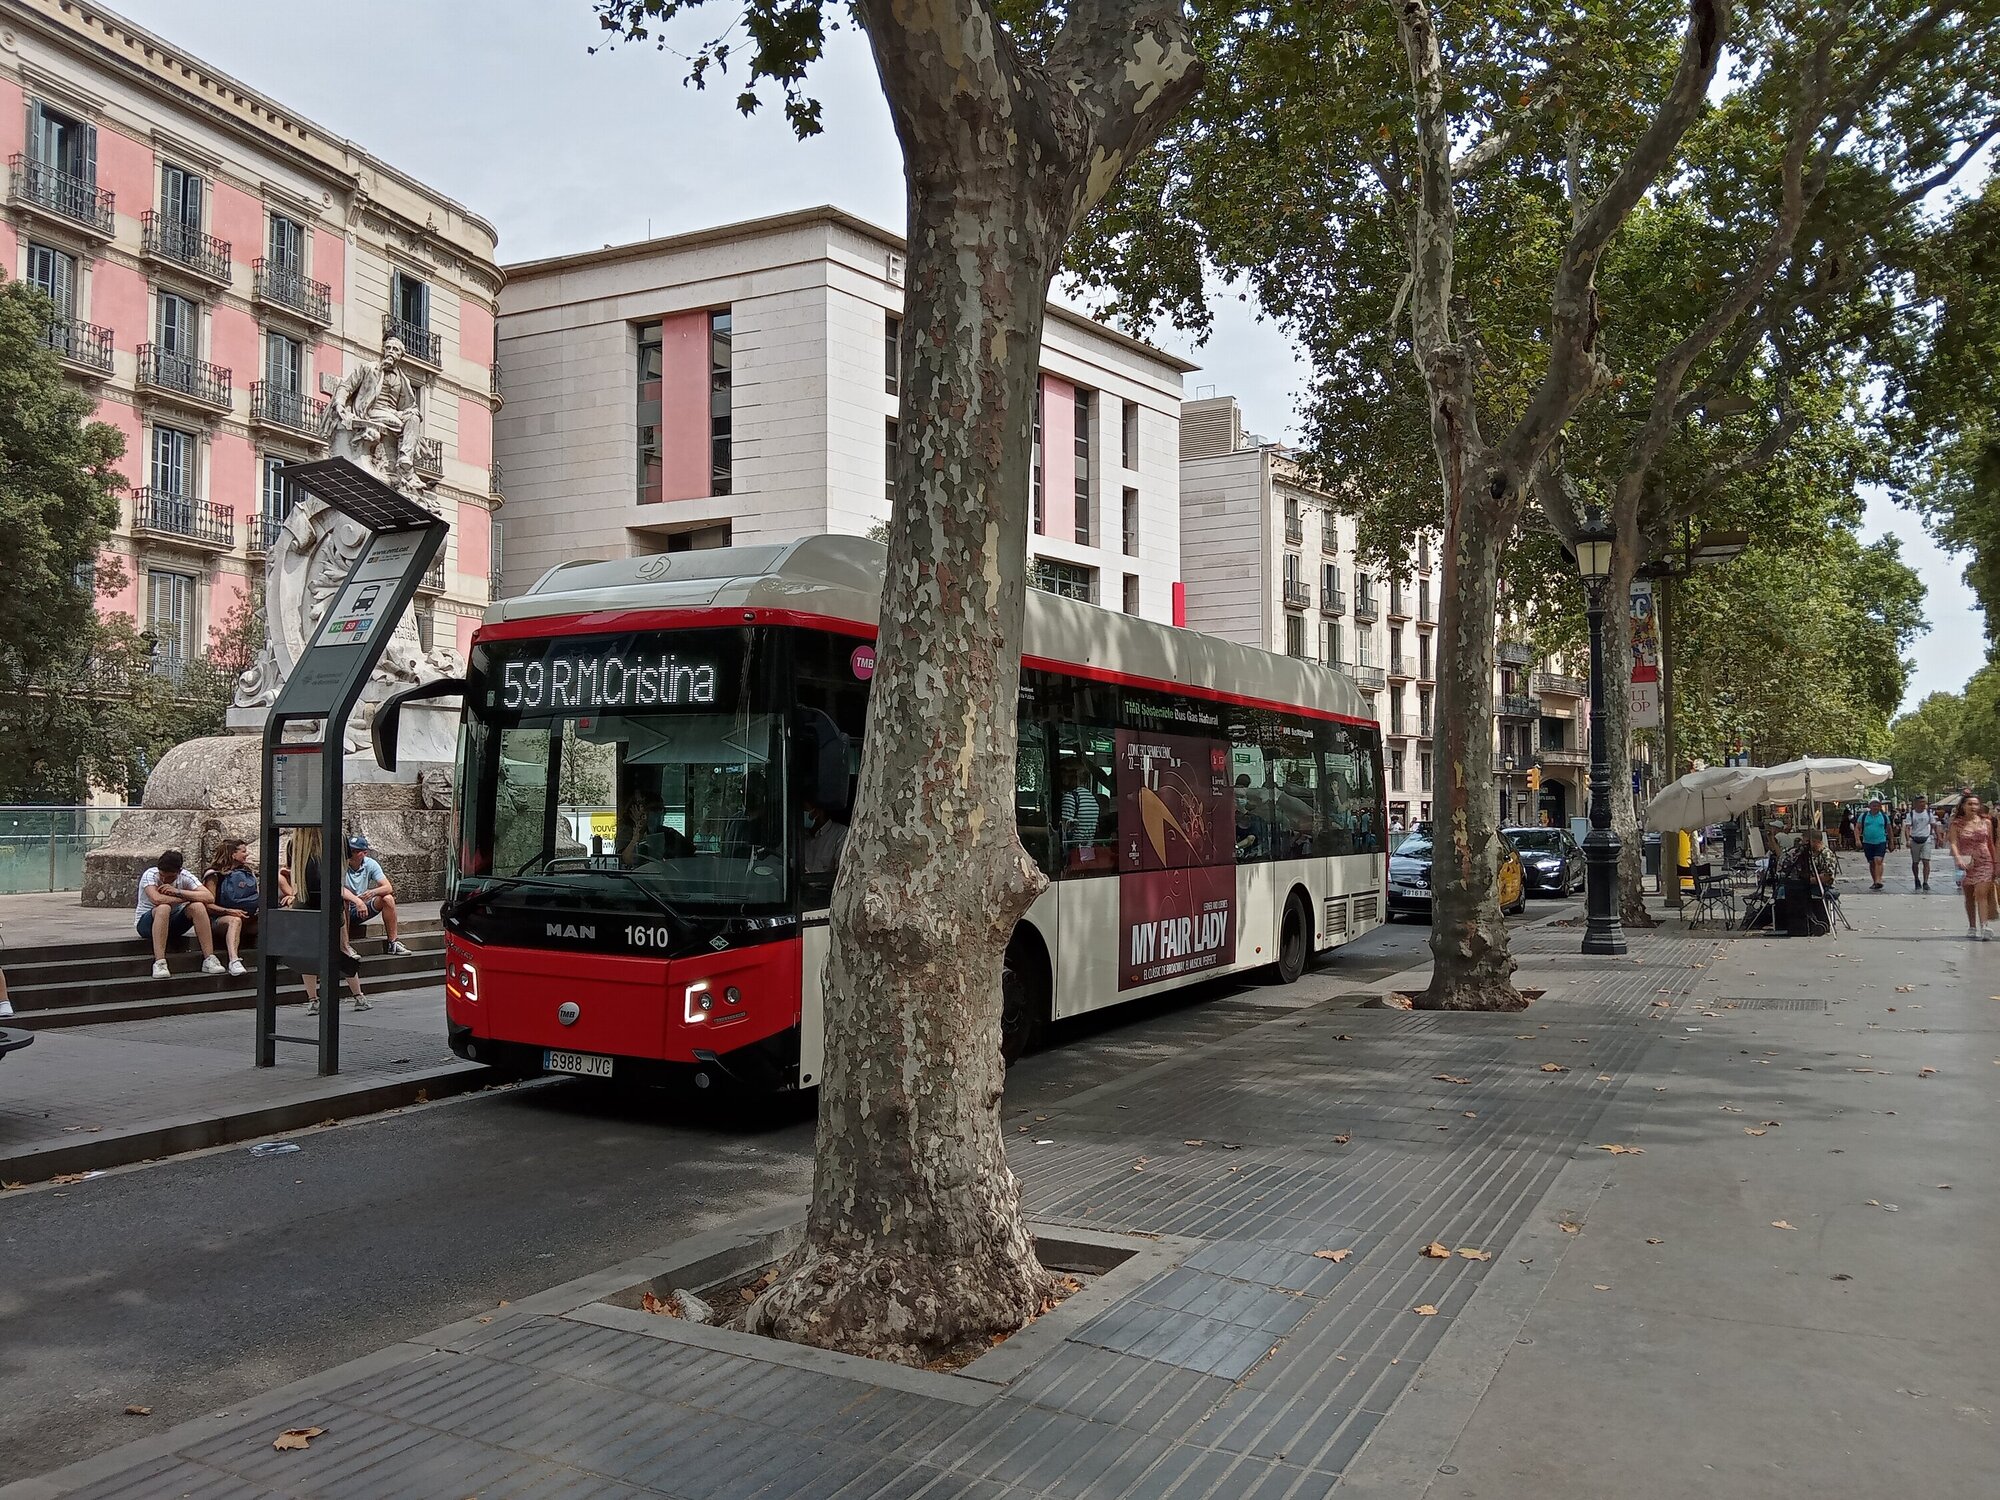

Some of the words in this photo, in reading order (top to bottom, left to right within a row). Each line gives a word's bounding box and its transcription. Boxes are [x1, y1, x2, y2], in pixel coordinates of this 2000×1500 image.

[345, 621, 357, 630] 59
[856, 656, 874, 669] TMB
[503, 660, 544, 708] 59
[551, 654, 714, 706] R.M.Cristina
[1186, 710, 1198, 723] Gas
[546, 923, 596, 939] MAN
[625, 925, 669, 948] 1610
[1131, 921, 1158, 966] MY
[1160, 916, 1191, 960] FAIR
[1194, 910, 1228, 953] LADY
[559, 1009, 576, 1019] TMB
[551, 1052, 582, 1072] 6988
[586, 1057, 611, 1076] JVC
